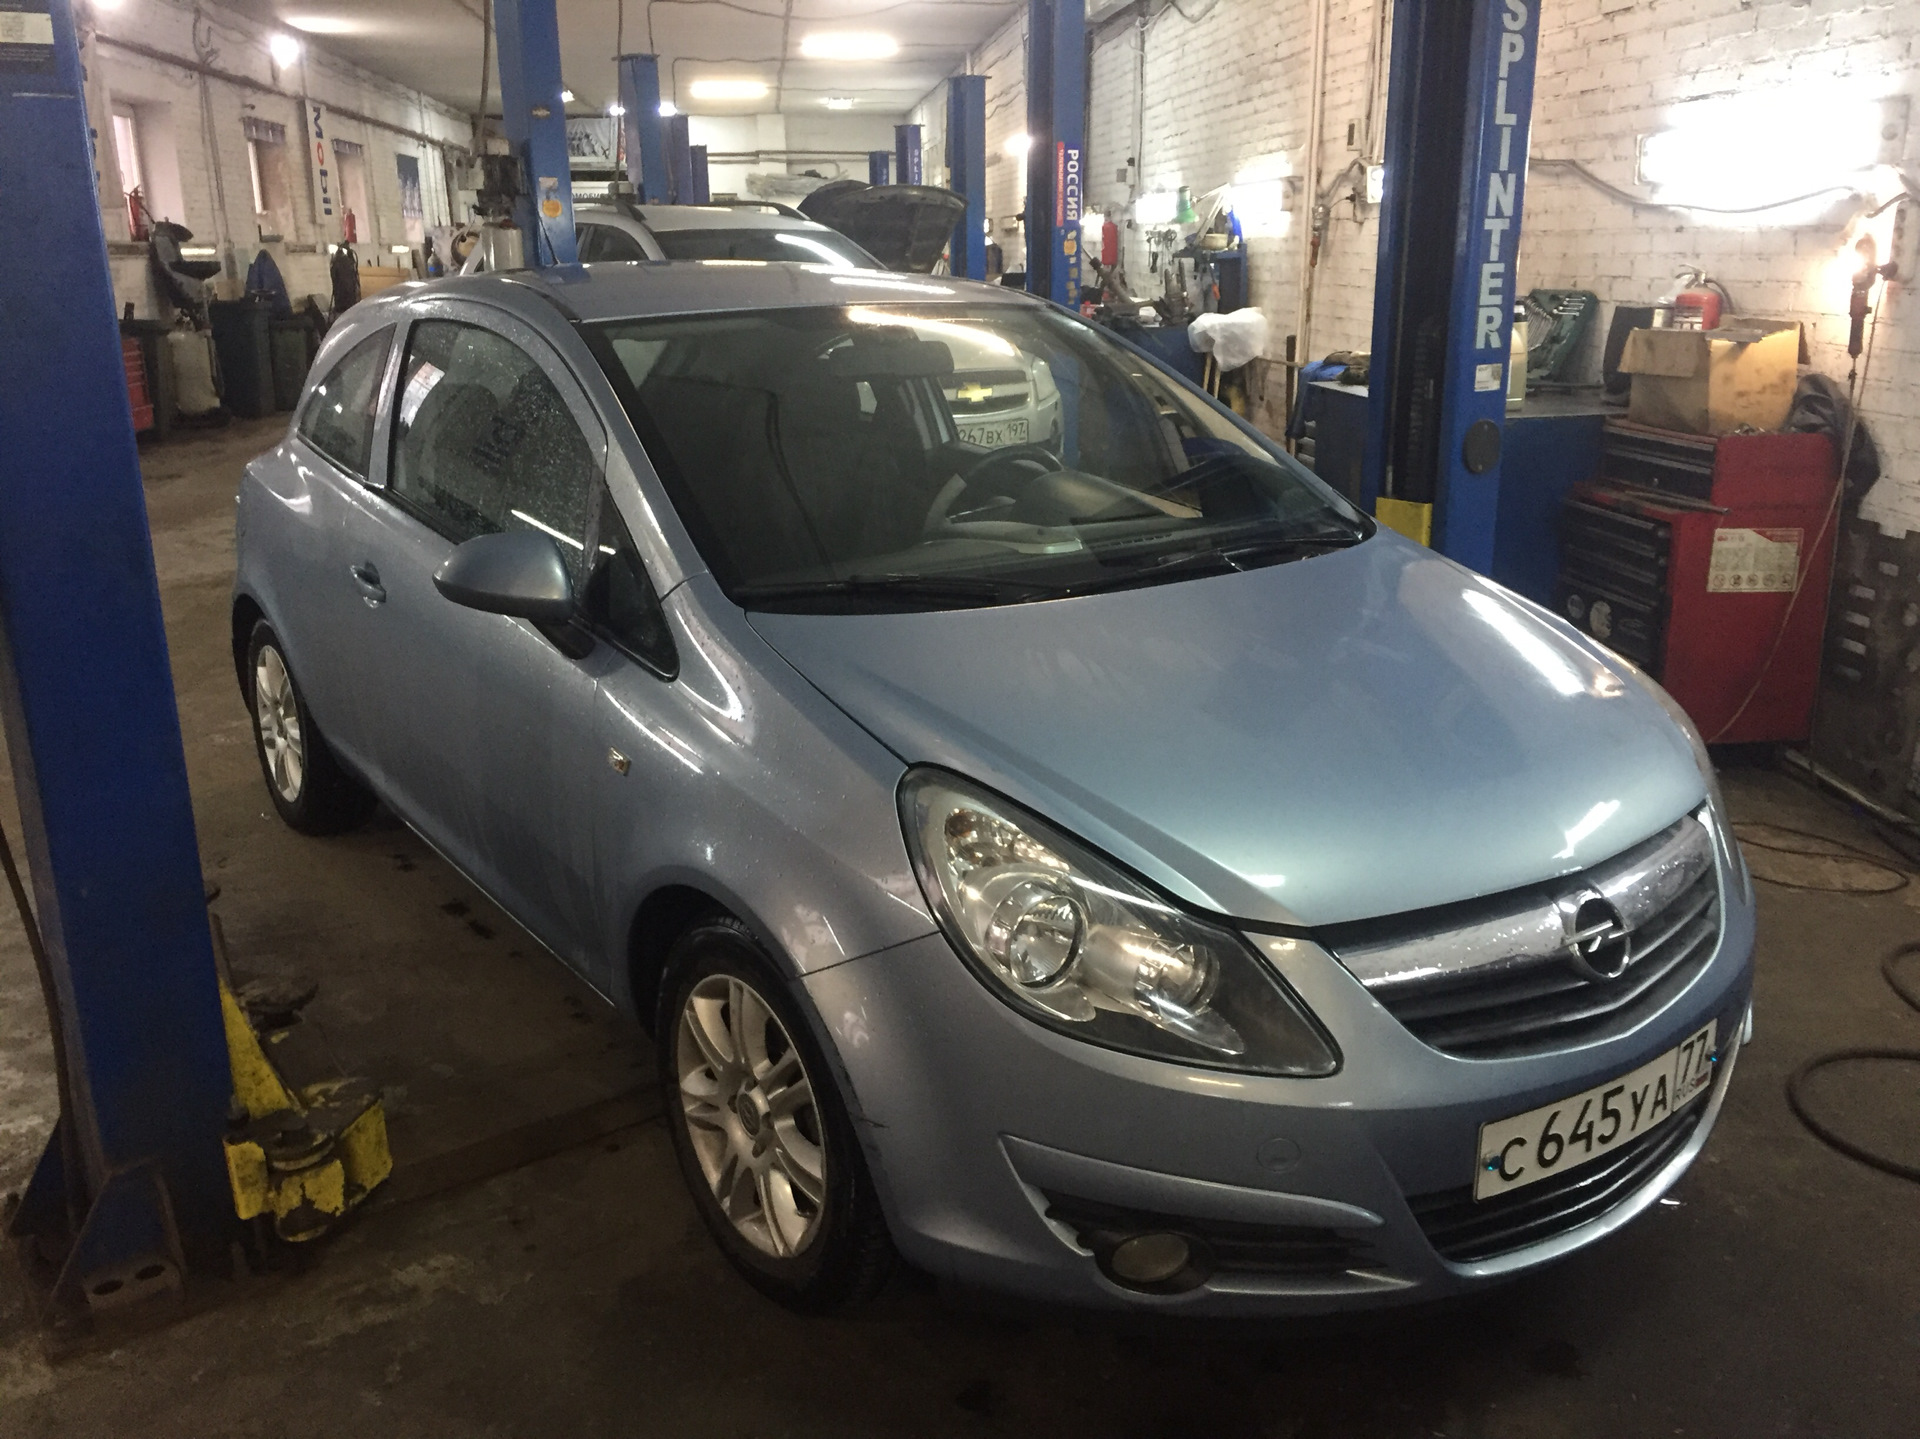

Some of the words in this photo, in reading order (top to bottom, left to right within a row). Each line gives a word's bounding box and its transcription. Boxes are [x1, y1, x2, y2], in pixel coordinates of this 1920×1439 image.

[312, 106, 333, 216] Mobil
[1066, 149, 1080, 221] РОССИЯ
[1475, 0, 1528, 350] SPLINTER
[1007, 422, 1025, 436] 197
[1499, 1073, 1668, 1182] С645УА
[1682, 1029, 1709, 1084] 77
[1675, 1077, 1698, 1100] RUS
